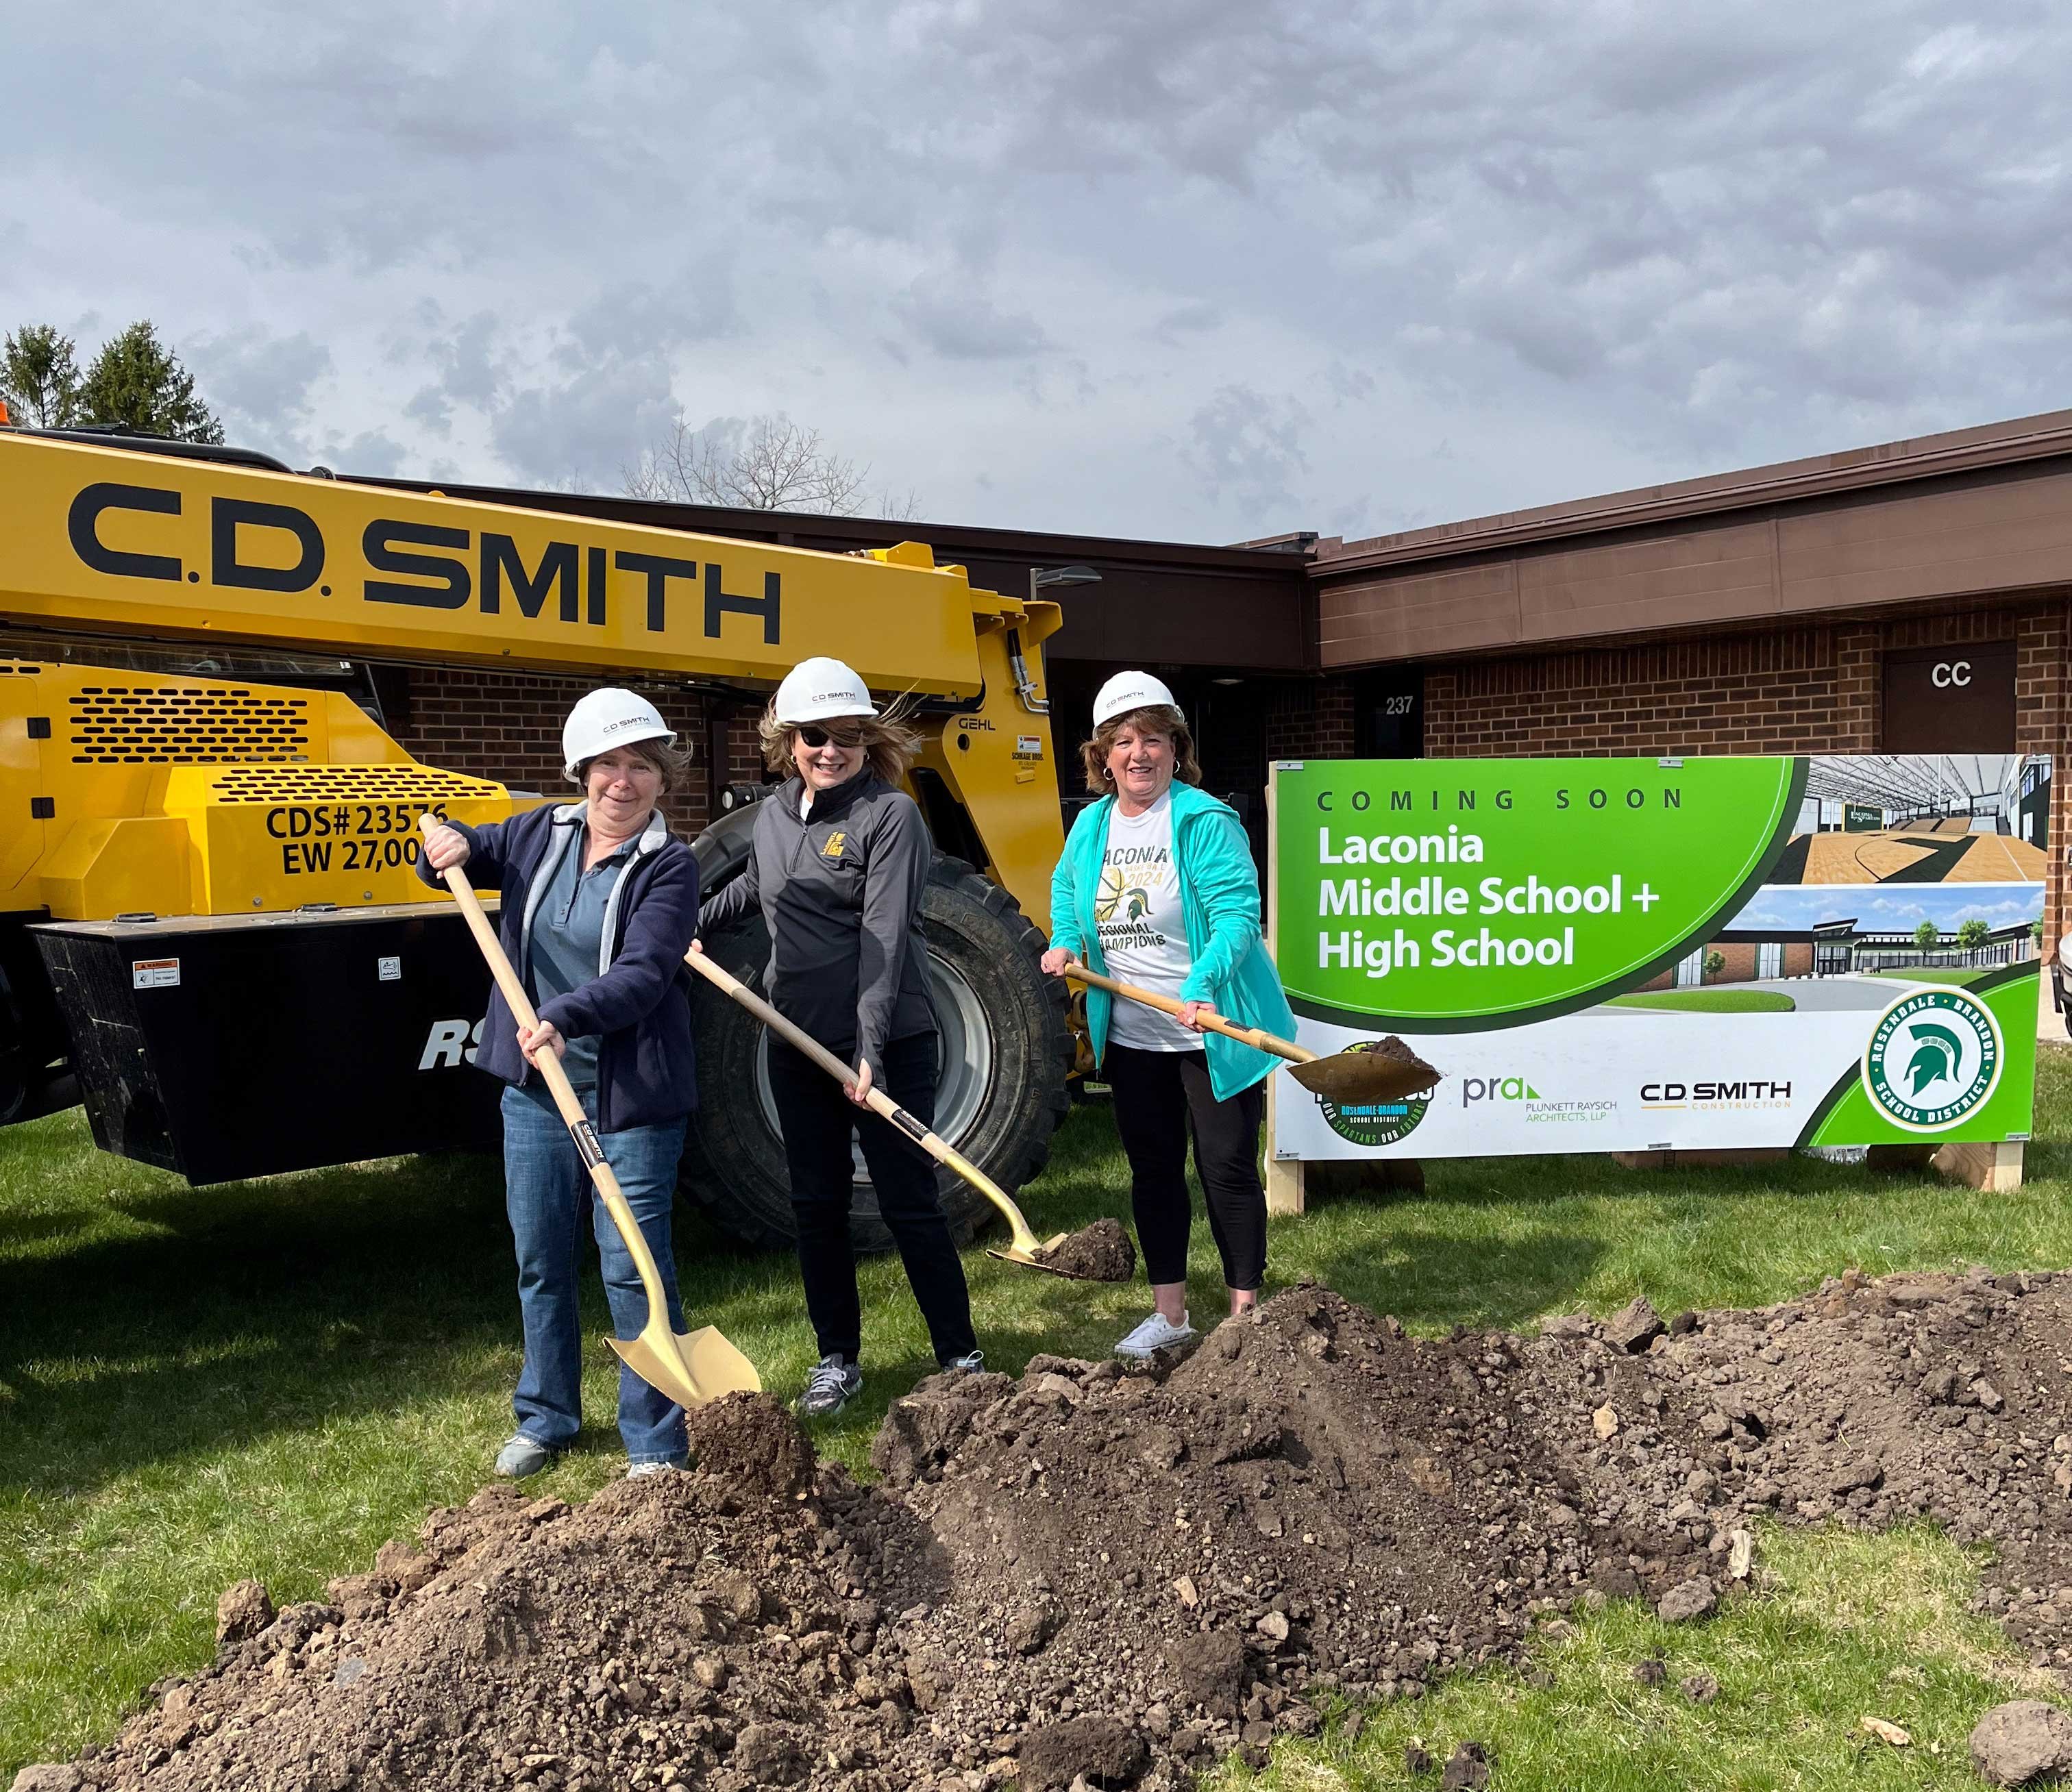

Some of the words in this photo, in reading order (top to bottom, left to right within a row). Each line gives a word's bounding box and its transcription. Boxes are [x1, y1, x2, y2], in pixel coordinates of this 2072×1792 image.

[69, 482, 332, 597] C.D.
[362, 519, 780, 645] SMITH
[1932, 662, 1971, 688] CC
[1386, 695, 1414, 714] 237
[619, 717, 650, 727] SMITH
[959, 717, 996, 731] GEHL
[1317, 790, 1514, 811] COMING
[1556, 788, 1681, 809] SOON
[1104, 845, 1168, 866] ACONIA
[1319, 824, 1483, 864] Laconia
[282, 841, 332, 875] EW
[342, 837, 421, 873] 27,00
[1125, 871, 1163, 888] 2024
[1318, 876, 1470, 916] Middle
[1479, 874, 1621, 914] School
[1097, 922, 1155, 937] EGIONAL
[1318, 929, 1420, 978] High
[1431, 927, 1574, 968] School
[1871, 995, 1936, 1062] ROSENDALE
[1953, 999, 1994, 1060] BRANDON
[1463, 1077, 1523, 1108] pra
[1693, 1081, 1792, 1099] SMITH
[1875, 1082, 1919, 1122] SCHOOL
[1927, 1075, 1988, 1123] DISTRICT
[1526, 1102, 1575, 1112] PLUNKETT
[1577, 1101, 1618, 1111] RAYSICH
[1526, 1112, 1588, 1122] ARCHITECTS,
[1590, 1111, 1607, 1121] LLP
[1692, 1101, 1791, 1110] CONSTRUCTION
[1322, 1102, 1337, 1121] OUR
[1381, 1130, 1399, 1143] OUR
